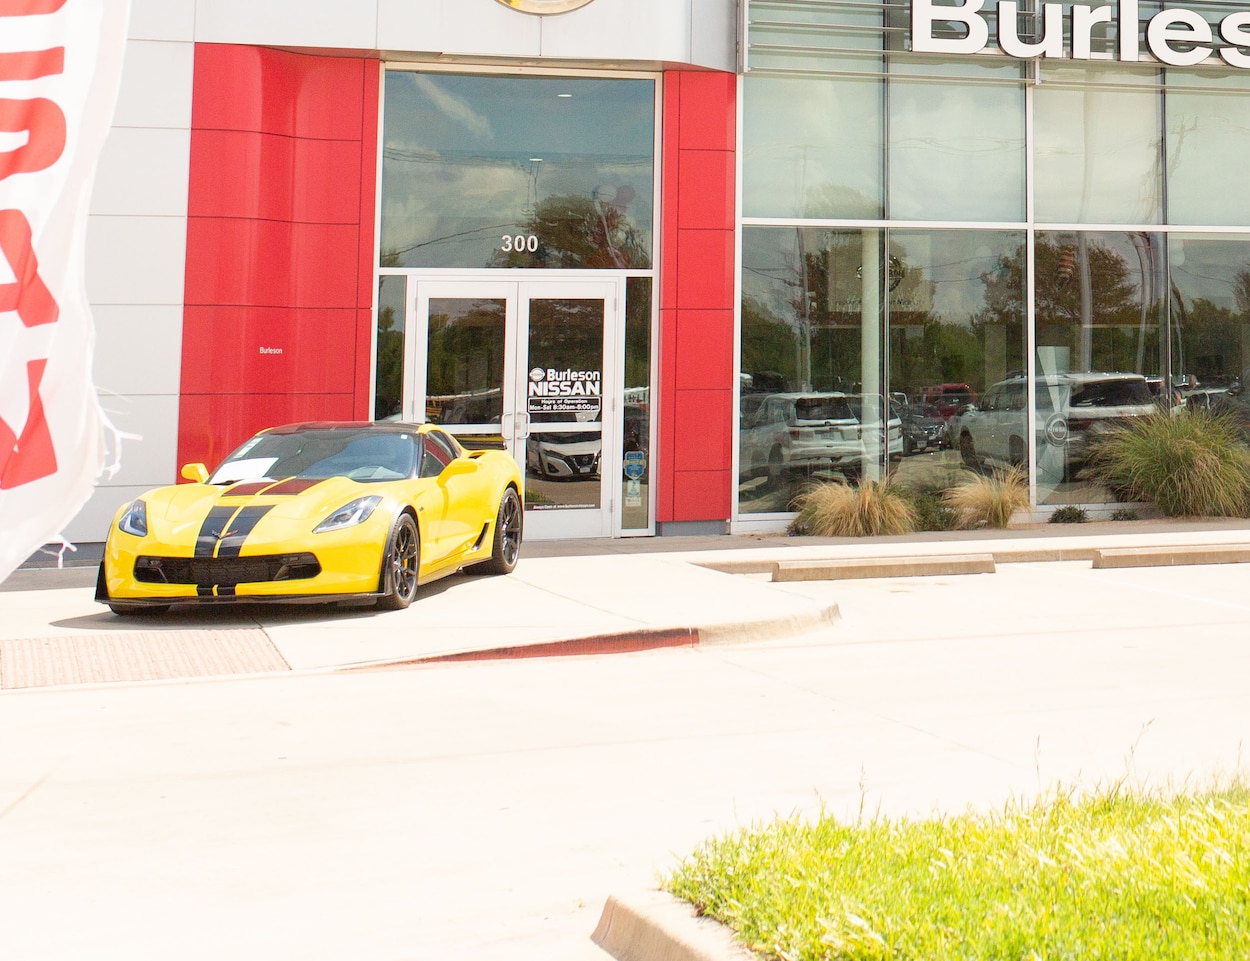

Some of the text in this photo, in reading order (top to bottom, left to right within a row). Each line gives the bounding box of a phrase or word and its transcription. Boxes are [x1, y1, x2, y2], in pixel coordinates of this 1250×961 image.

[501, 234, 539, 253] 300
[259, 346, 283, 354] Burleson
[547, 368, 600, 381] Burleson
[529, 381, 600, 396] NISSAN
